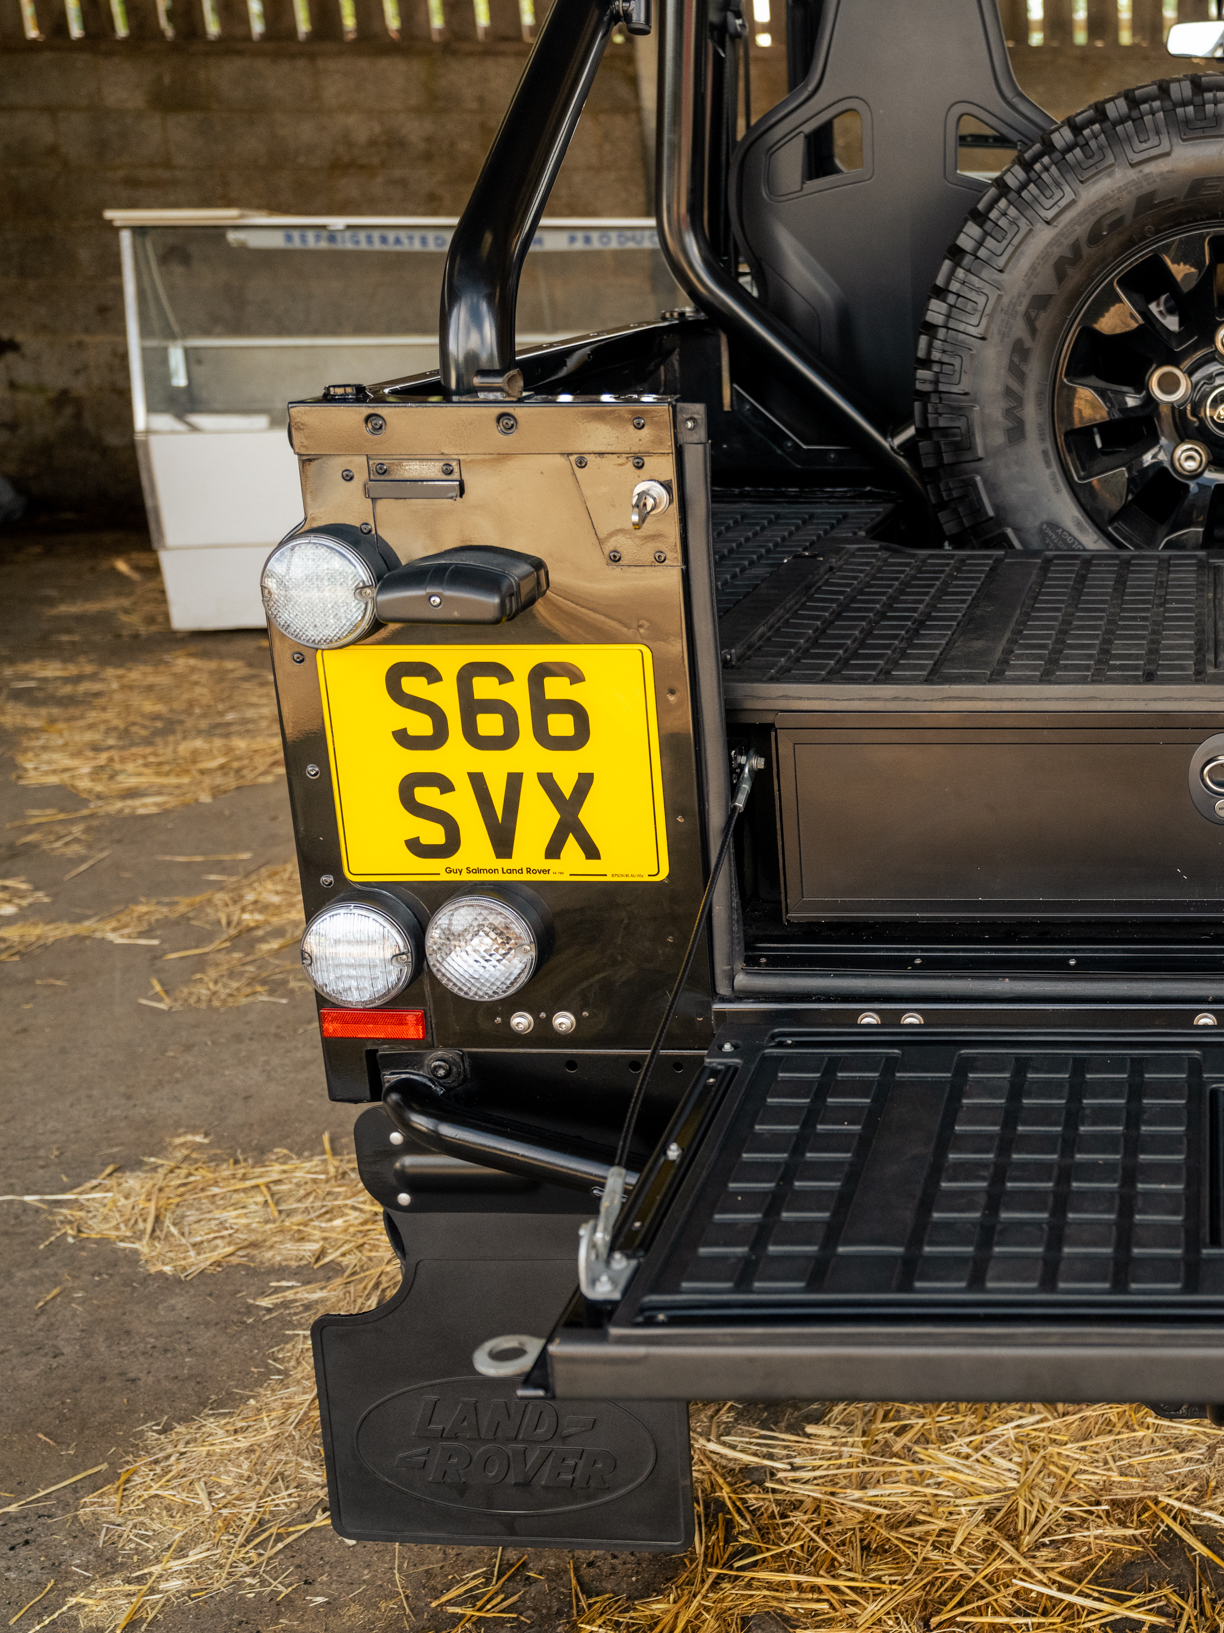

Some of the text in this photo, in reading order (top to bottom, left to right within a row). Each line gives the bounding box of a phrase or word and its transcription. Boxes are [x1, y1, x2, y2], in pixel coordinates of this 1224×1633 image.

[284, 230, 448, 248] REFRIGERATED
[385, 661, 591, 751] S66
[398, 772, 602, 860] SVX
[445, 867, 463, 876] Guy
[466, 866, 499, 875] Salmon
[502, 866, 523, 875] Land
[526, 867, 551, 875] Rover
[411, 1396, 559, 1442] LAND
[428, 1442, 617, 1489] ROVER
